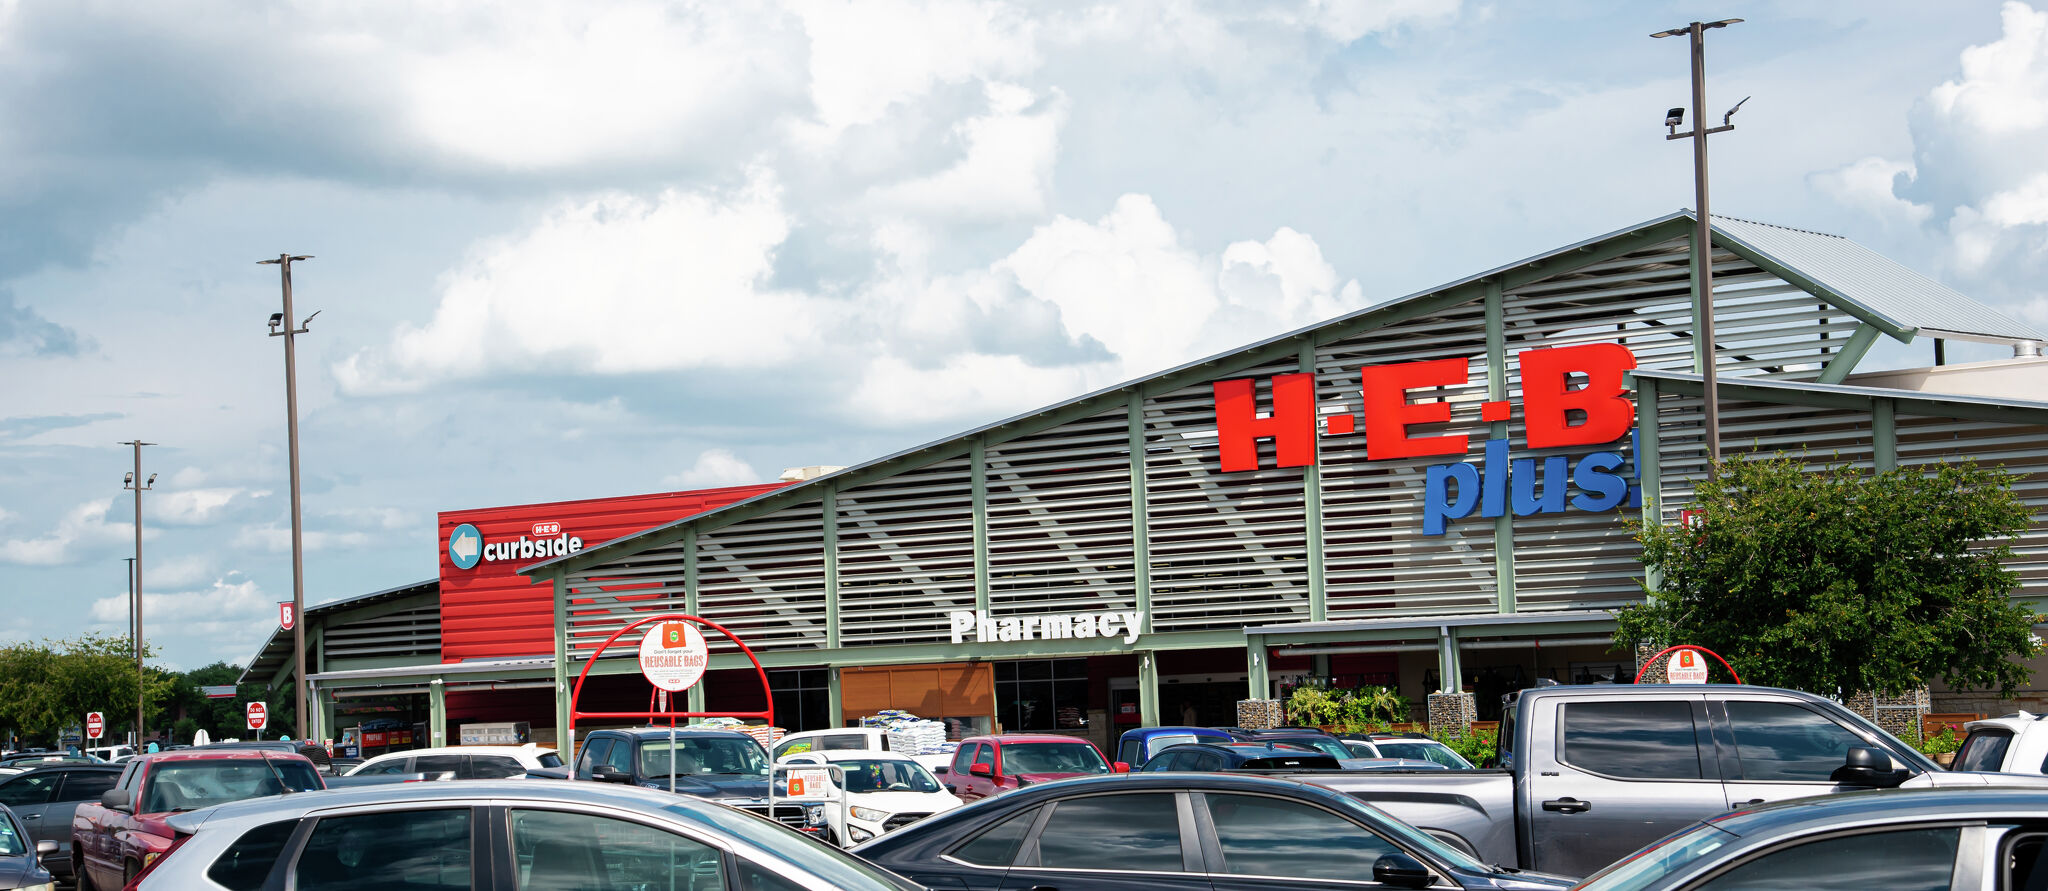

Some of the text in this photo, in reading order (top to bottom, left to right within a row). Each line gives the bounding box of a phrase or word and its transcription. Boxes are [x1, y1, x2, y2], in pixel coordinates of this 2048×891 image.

[484, 533, 583, 562] curbside
[282, 606, 293, 624] B
[951, 610, 1144, 645] Pharmacy
[645, 655, 704, 668] REUSABLE BAGS
[1670, 671, 1705, 681] REUSABLE BAGS
[804, 774, 826, 782] REUSABLE
